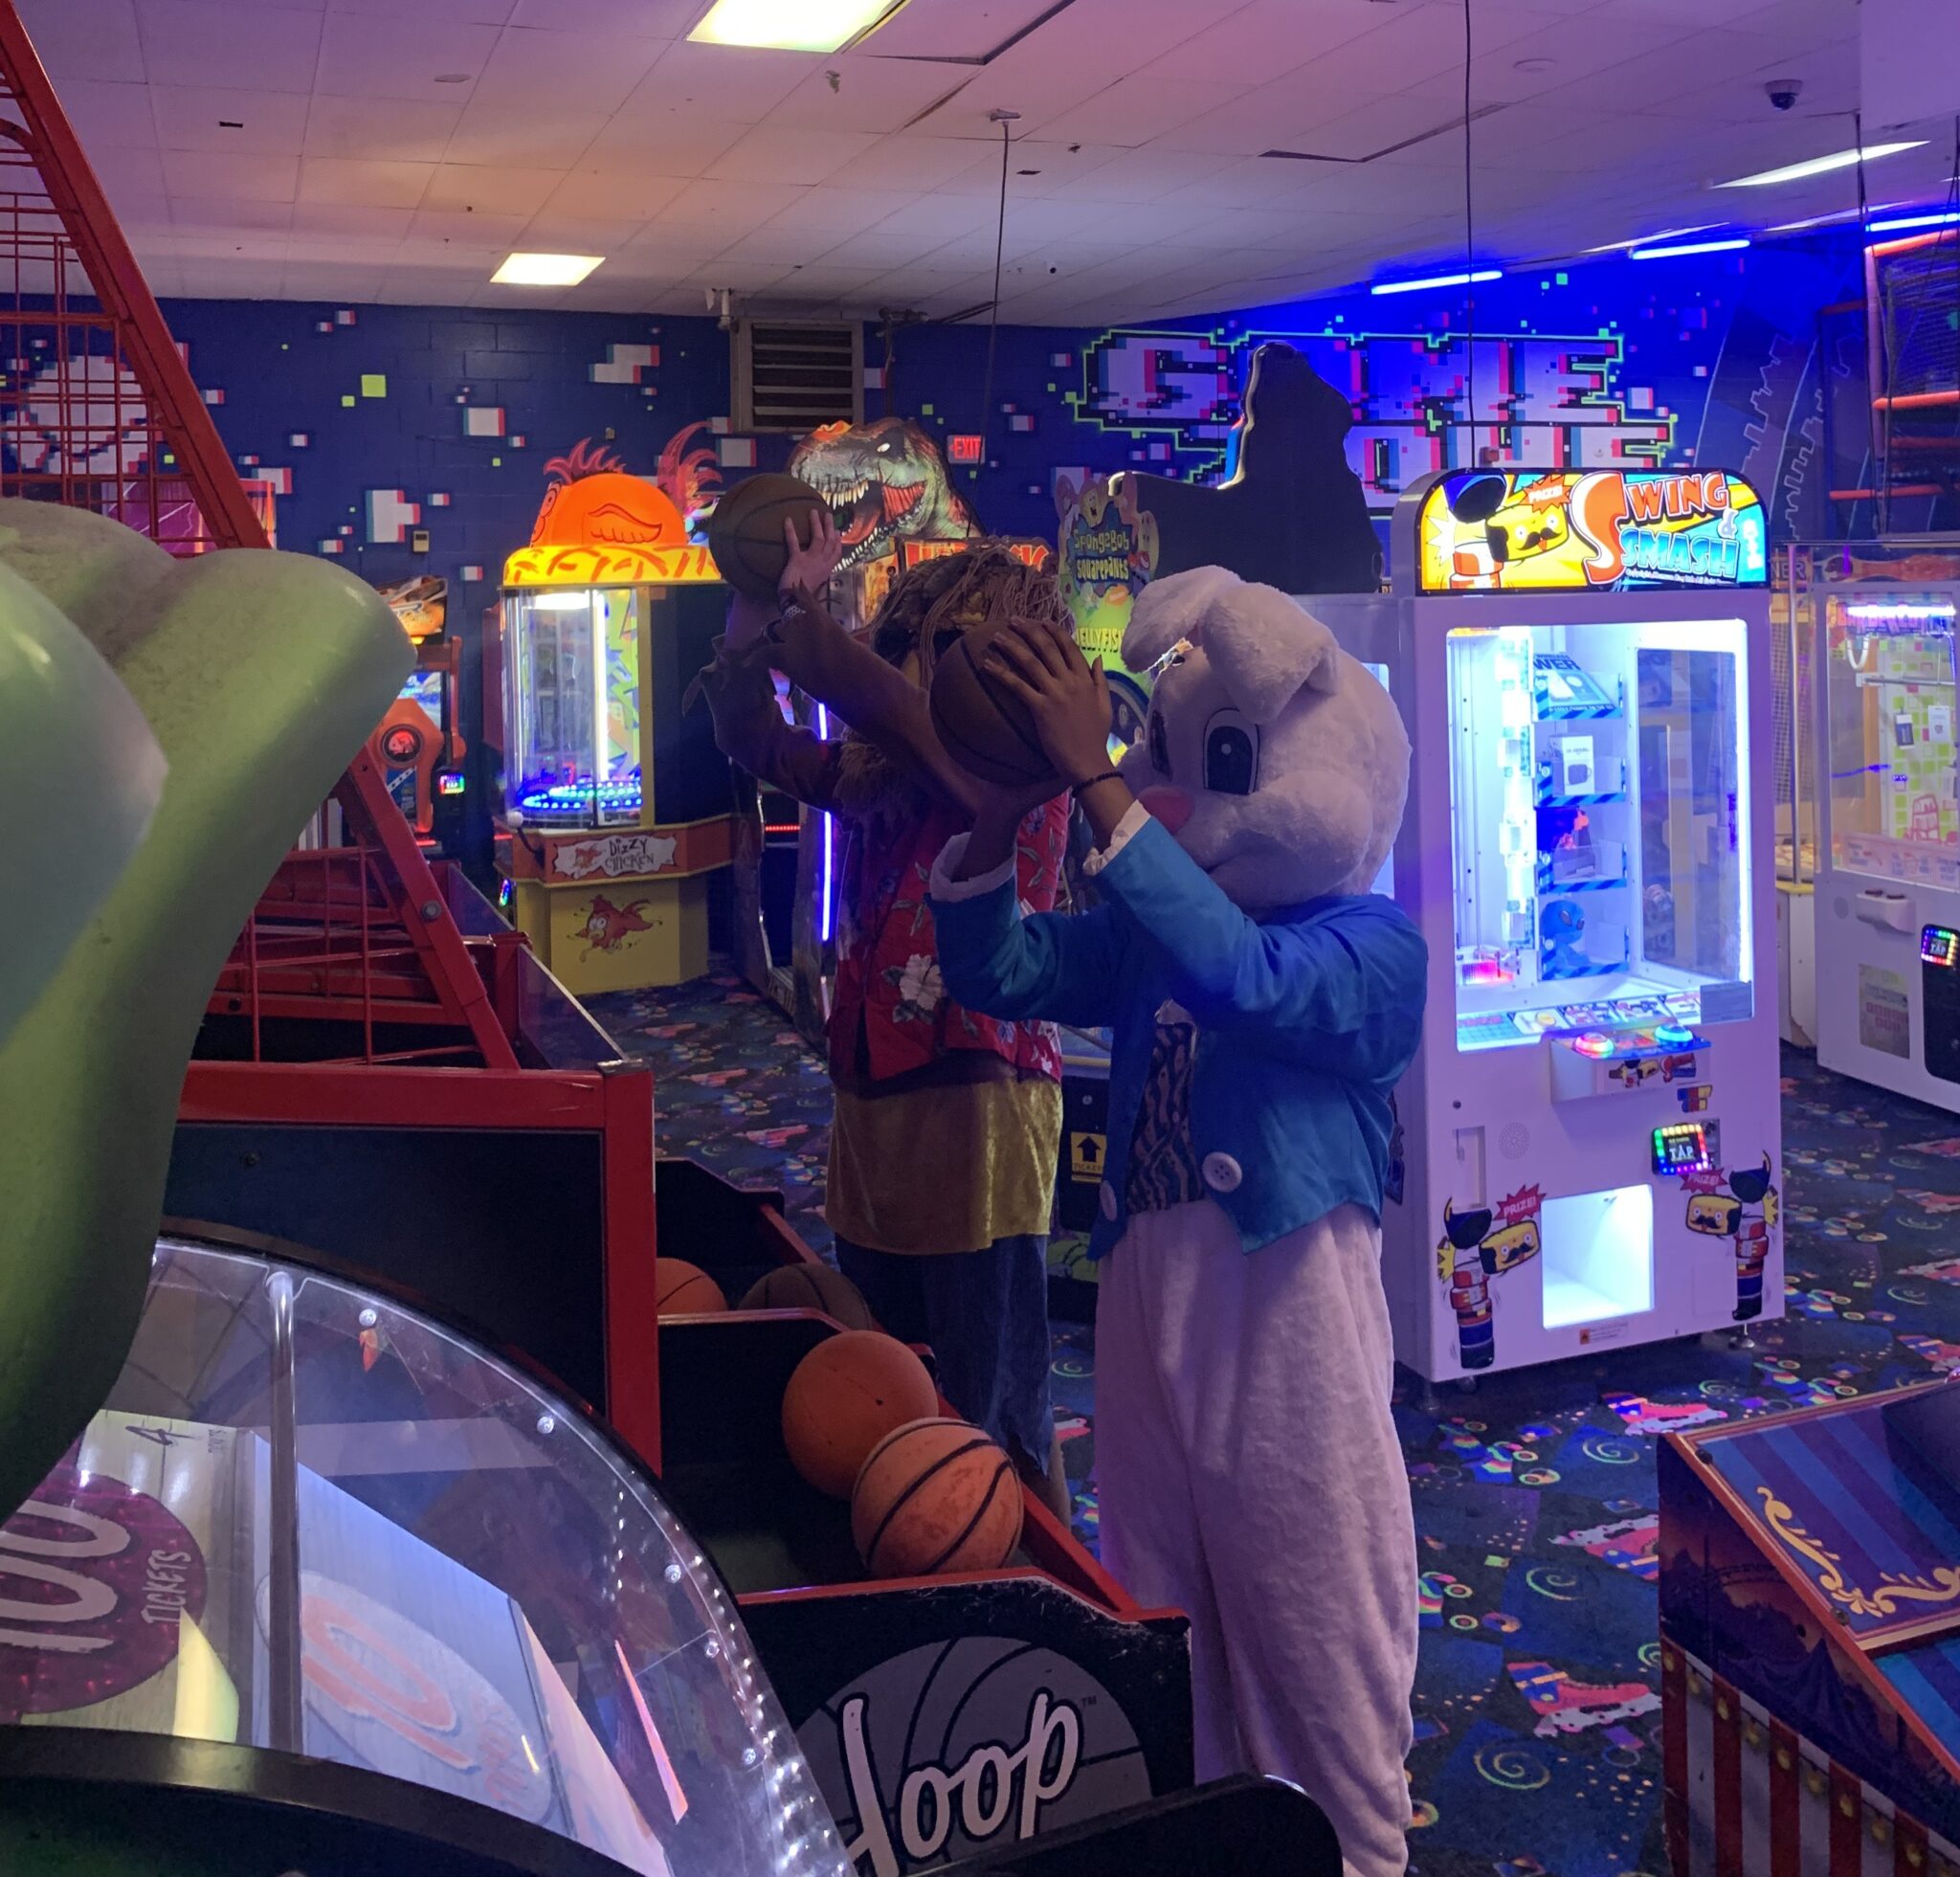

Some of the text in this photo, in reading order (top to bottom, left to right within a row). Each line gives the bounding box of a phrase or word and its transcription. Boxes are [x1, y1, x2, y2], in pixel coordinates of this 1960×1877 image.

[1099, 337, 1621, 423] GME
[954, 436, 981, 459] EXIT
[1619, 528, 1739, 580] SMASH
[605, 854, 654, 872] CHICKEN
[1668, 1144, 1694, 1161] TAP
[141, 1549, 191, 1624] TICKETS
